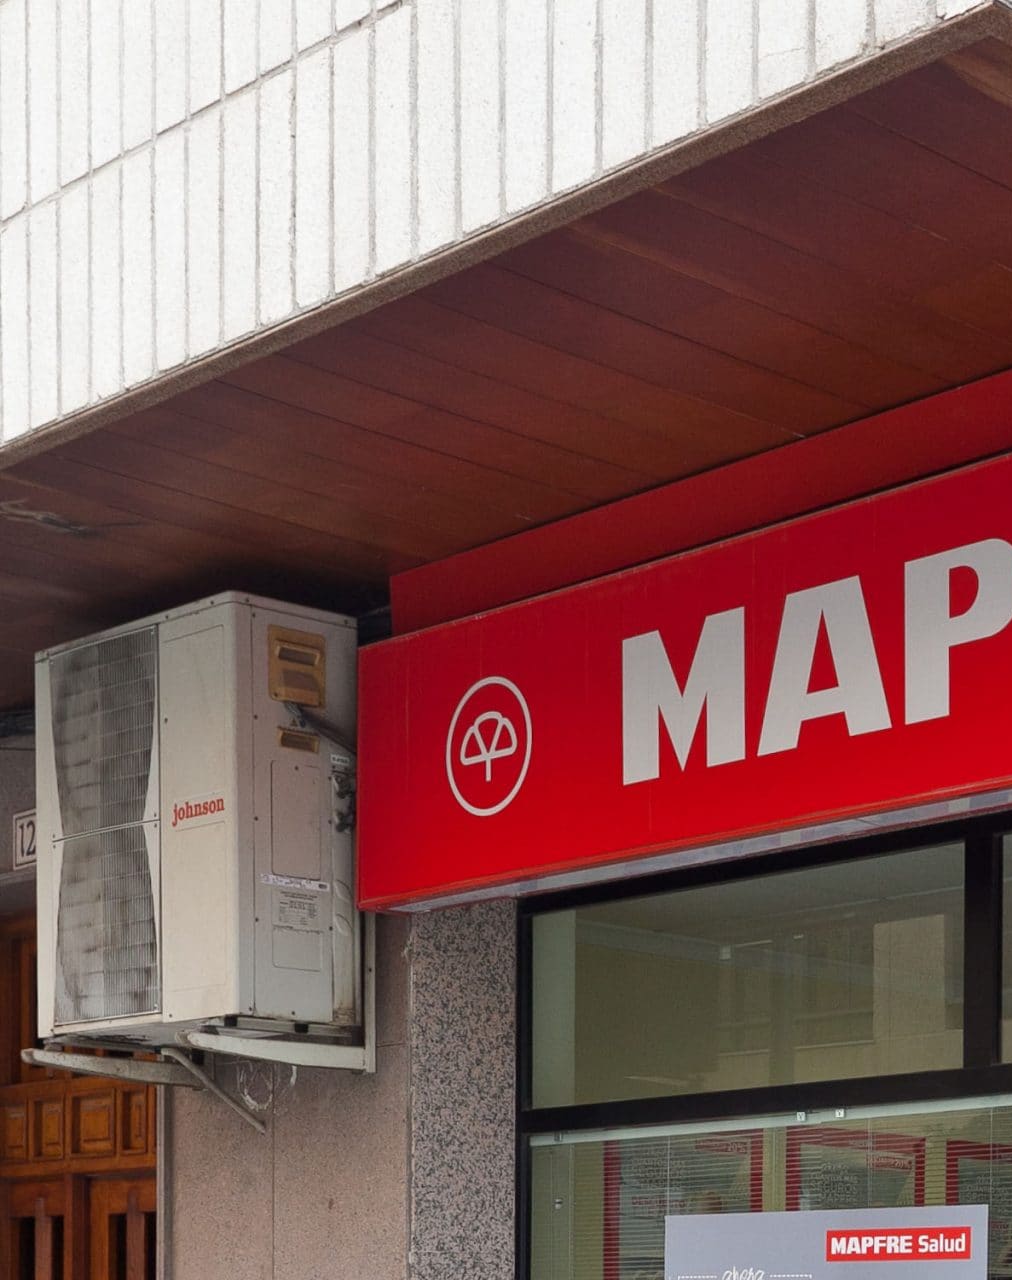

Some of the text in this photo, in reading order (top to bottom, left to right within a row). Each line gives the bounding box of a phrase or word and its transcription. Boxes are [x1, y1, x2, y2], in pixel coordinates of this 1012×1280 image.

[171, 798, 225, 827] johnson
[19, 820, 36, 857] 12
[831, 1232, 966, 1255] MAPFRE Salud
